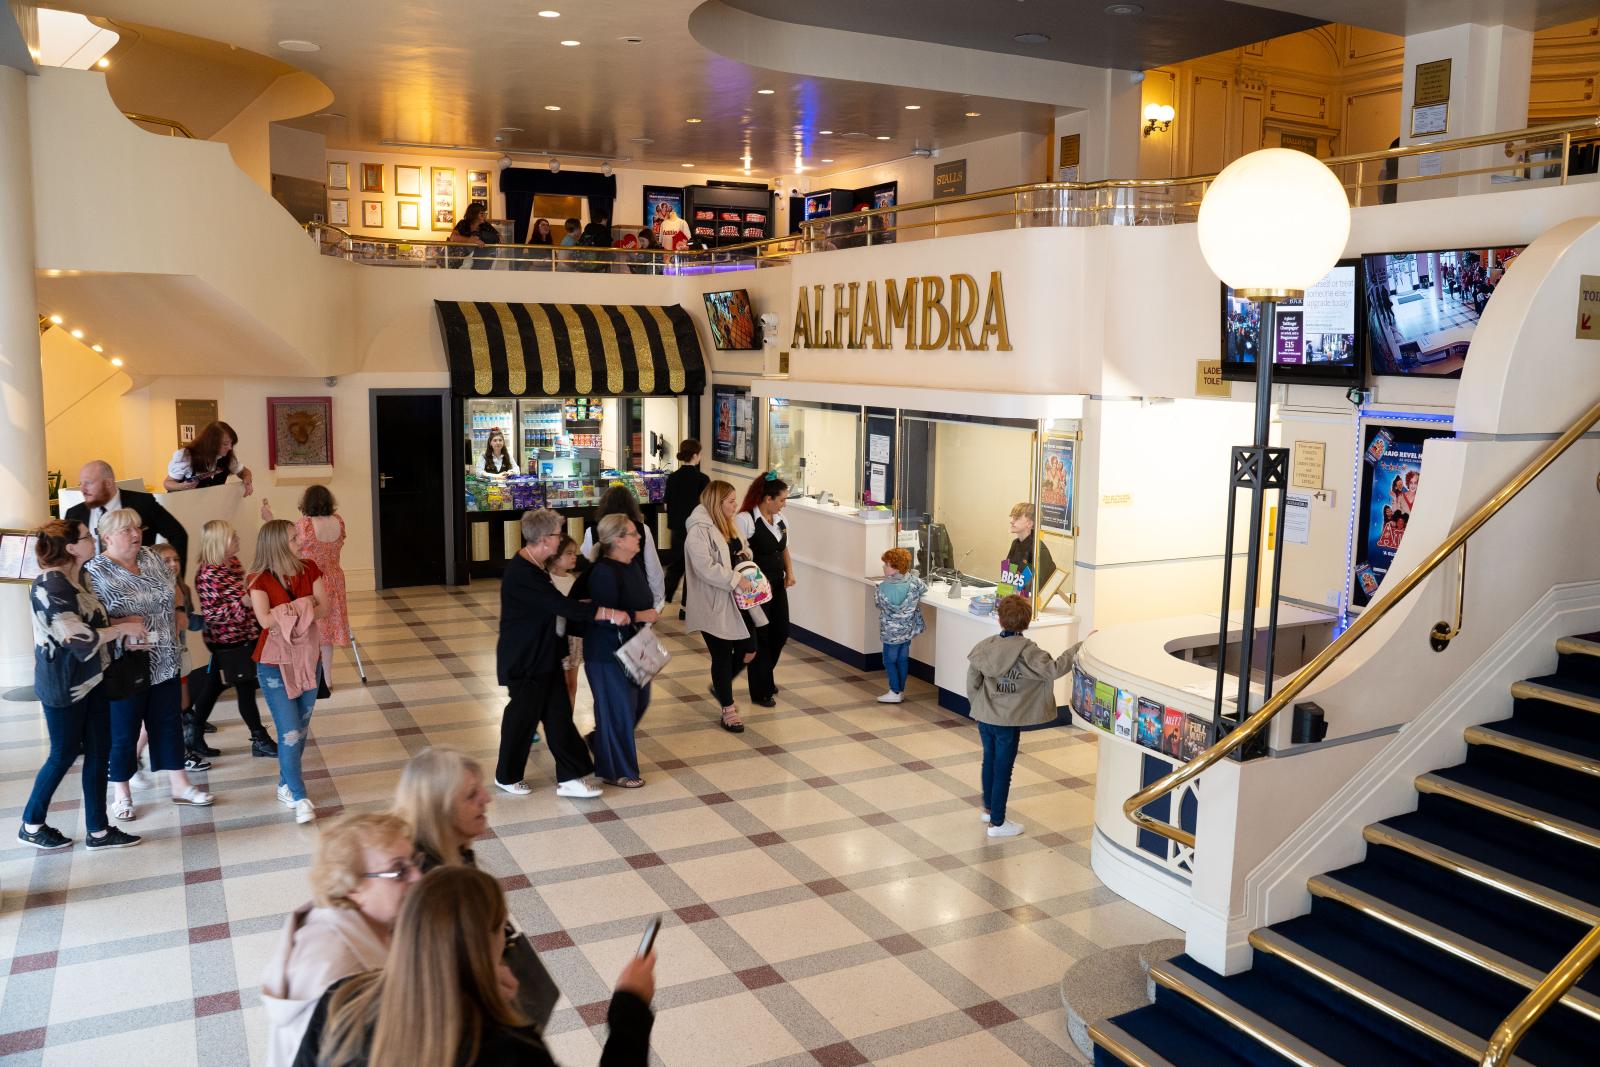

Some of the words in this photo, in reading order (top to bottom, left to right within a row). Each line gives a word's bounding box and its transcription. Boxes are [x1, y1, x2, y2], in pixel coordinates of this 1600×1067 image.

[791, 271, 1013, 351] ALHAMBRA
[1203, 367, 1223, 375] LADIE
[1399, 451, 1418, 459] REVEL
[1001, 570, 1025, 587] BD25
[996, 682, 1017, 693] KIND
